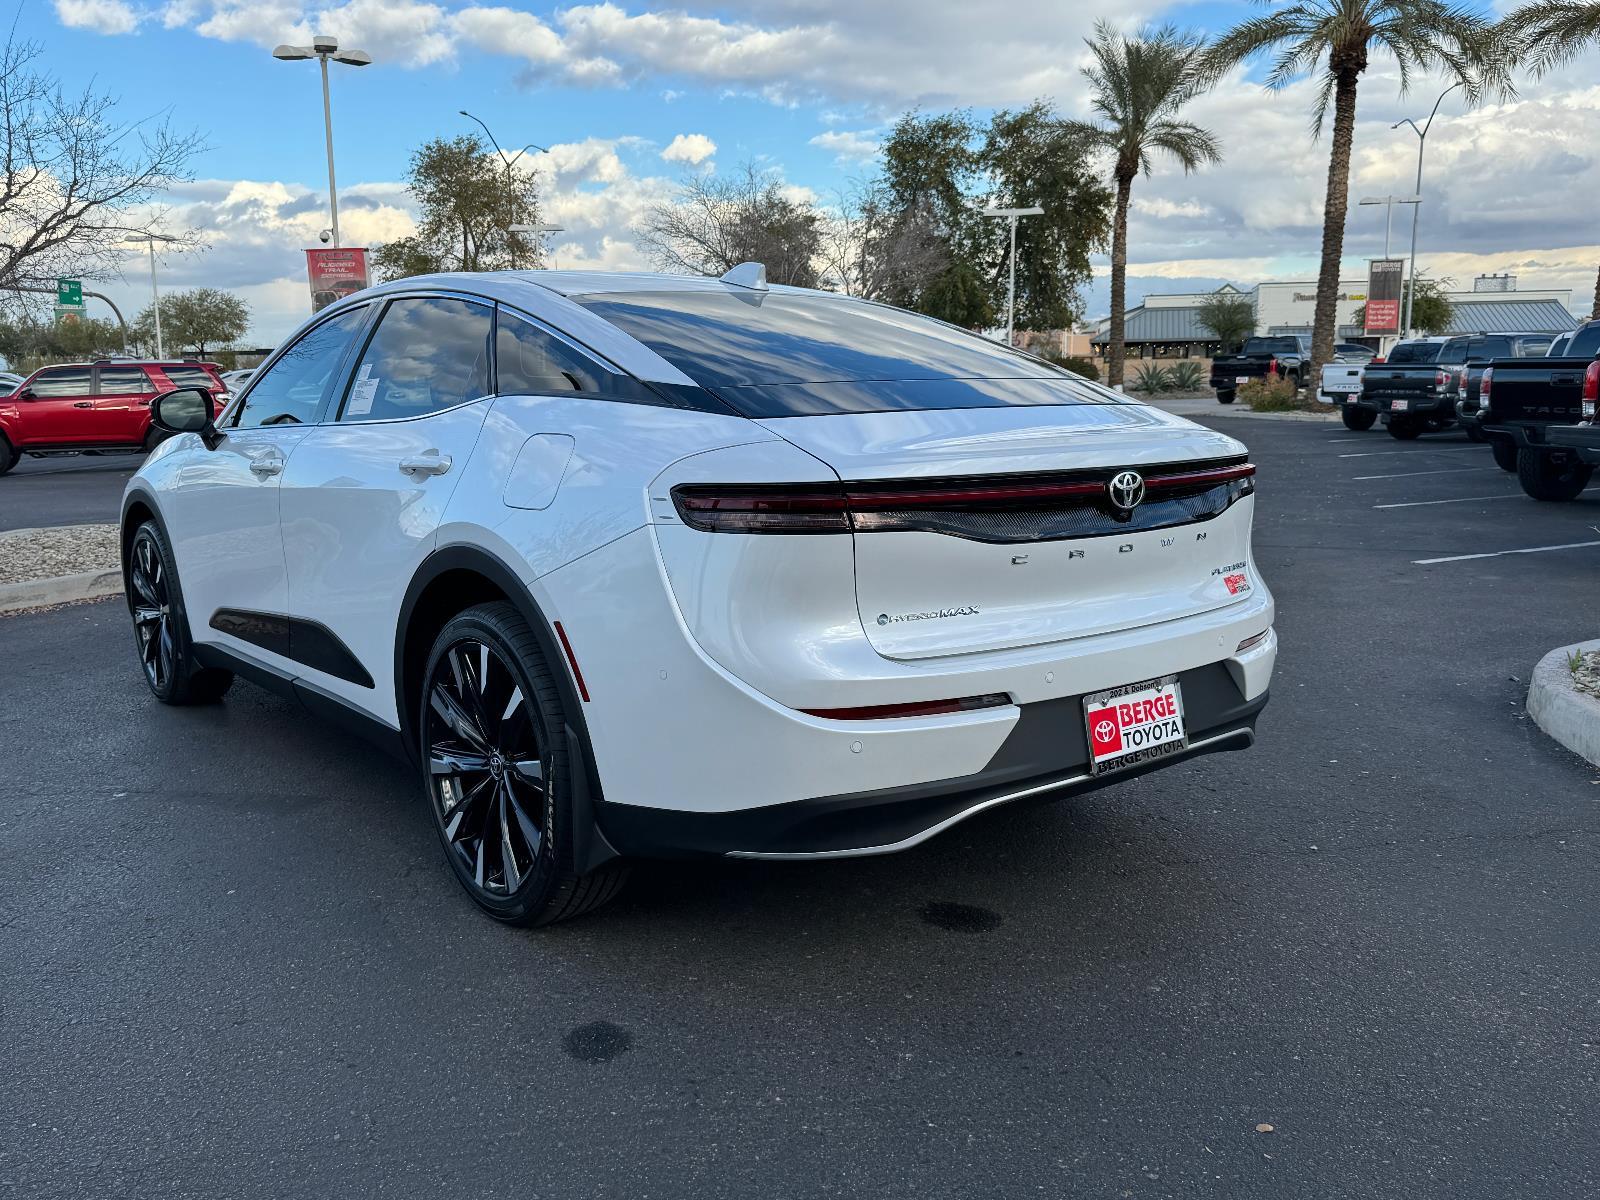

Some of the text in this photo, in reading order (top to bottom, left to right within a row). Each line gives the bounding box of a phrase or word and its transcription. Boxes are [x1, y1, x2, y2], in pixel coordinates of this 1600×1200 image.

[1522, 406, 1581, 414] TACO
[1011, 532, 1207, 565] CROWN
[1109, 688, 1123, 698] 202
[1131, 682, 1155, 693] Dobson
[1118, 693, 1176, 727] BERGE
[1123, 720, 1181, 748] TOYOTA
[1097, 740, 1184, 773] BERGE TOYOTA
